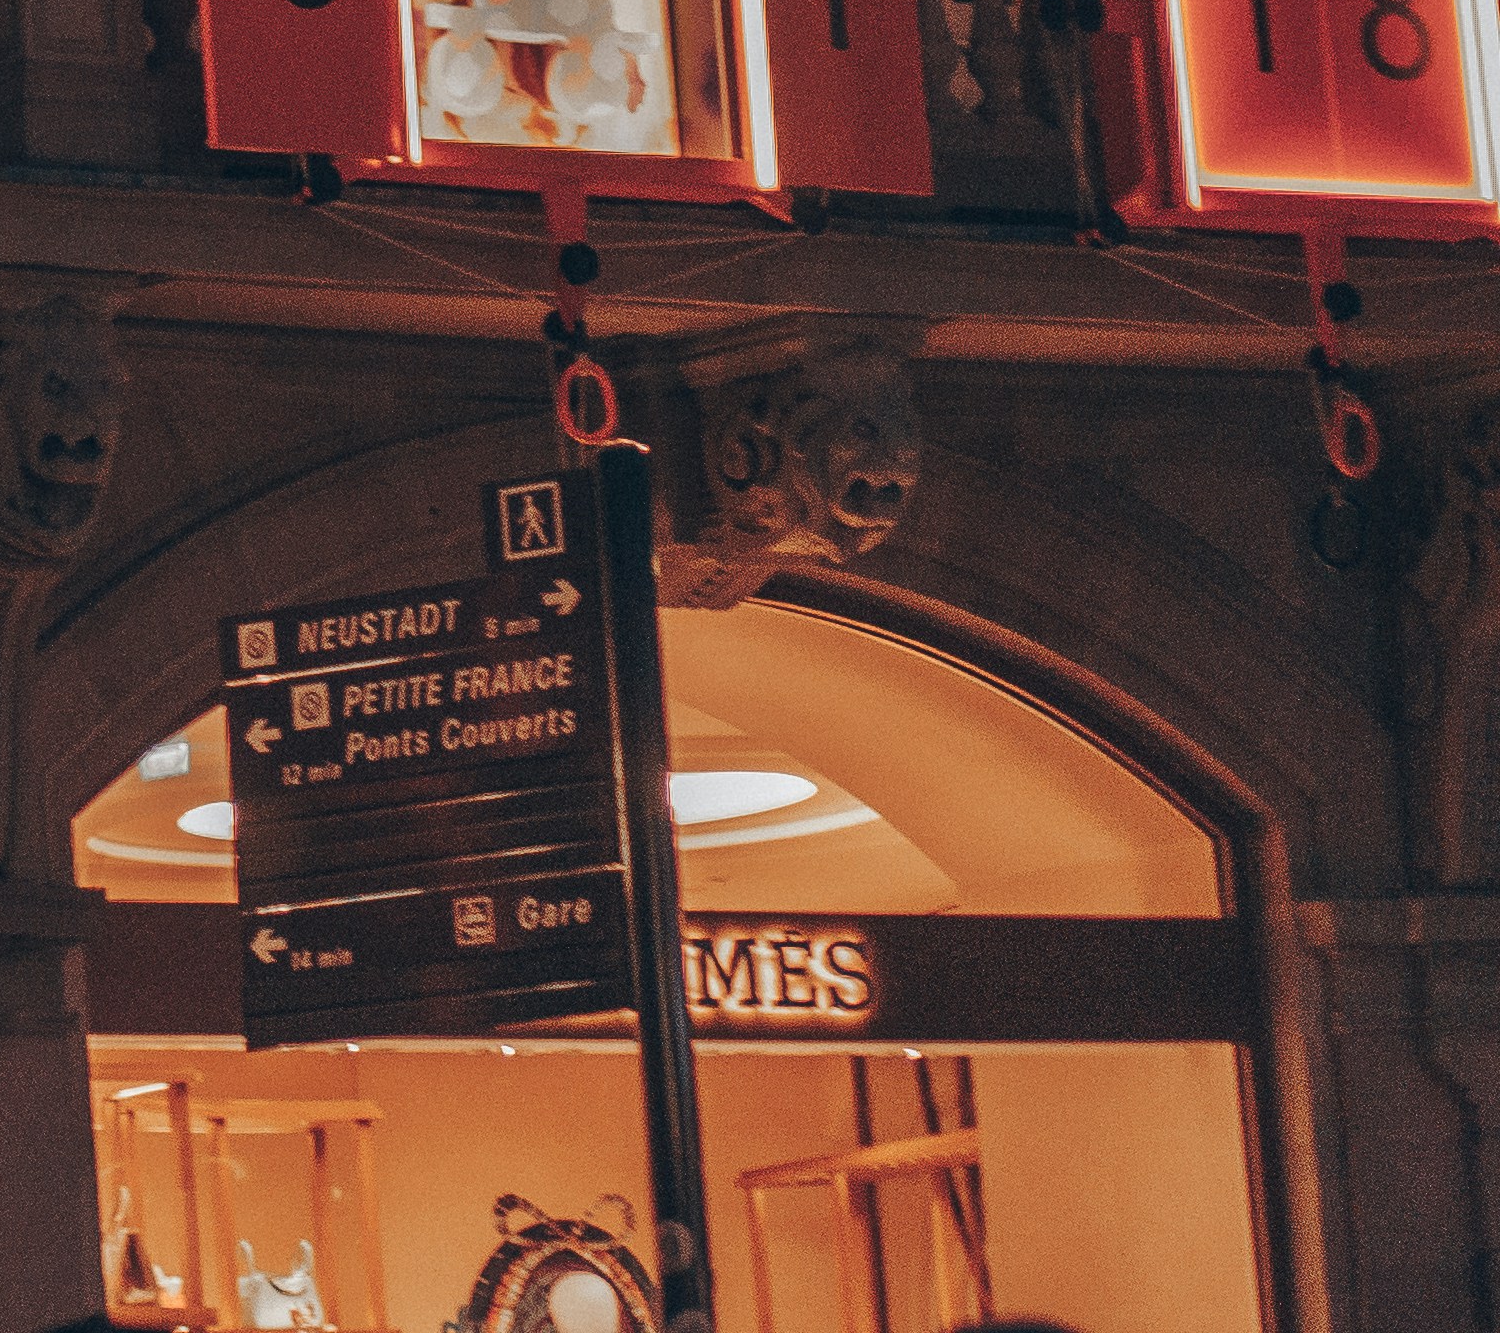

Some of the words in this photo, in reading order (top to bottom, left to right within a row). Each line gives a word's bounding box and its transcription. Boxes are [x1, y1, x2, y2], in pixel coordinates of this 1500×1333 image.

[297, 599, 462, 654] NEUSTADT
[343, 673, 444, 718] PETITE
[452, 654, 575, 703] FRANCE
[345, 730, 430, 765] Ponts
[441, 709, 577, 751] Couverts
[516, 897, 593, 931] Gare
[688, 930, 872, 1011] MÈS
